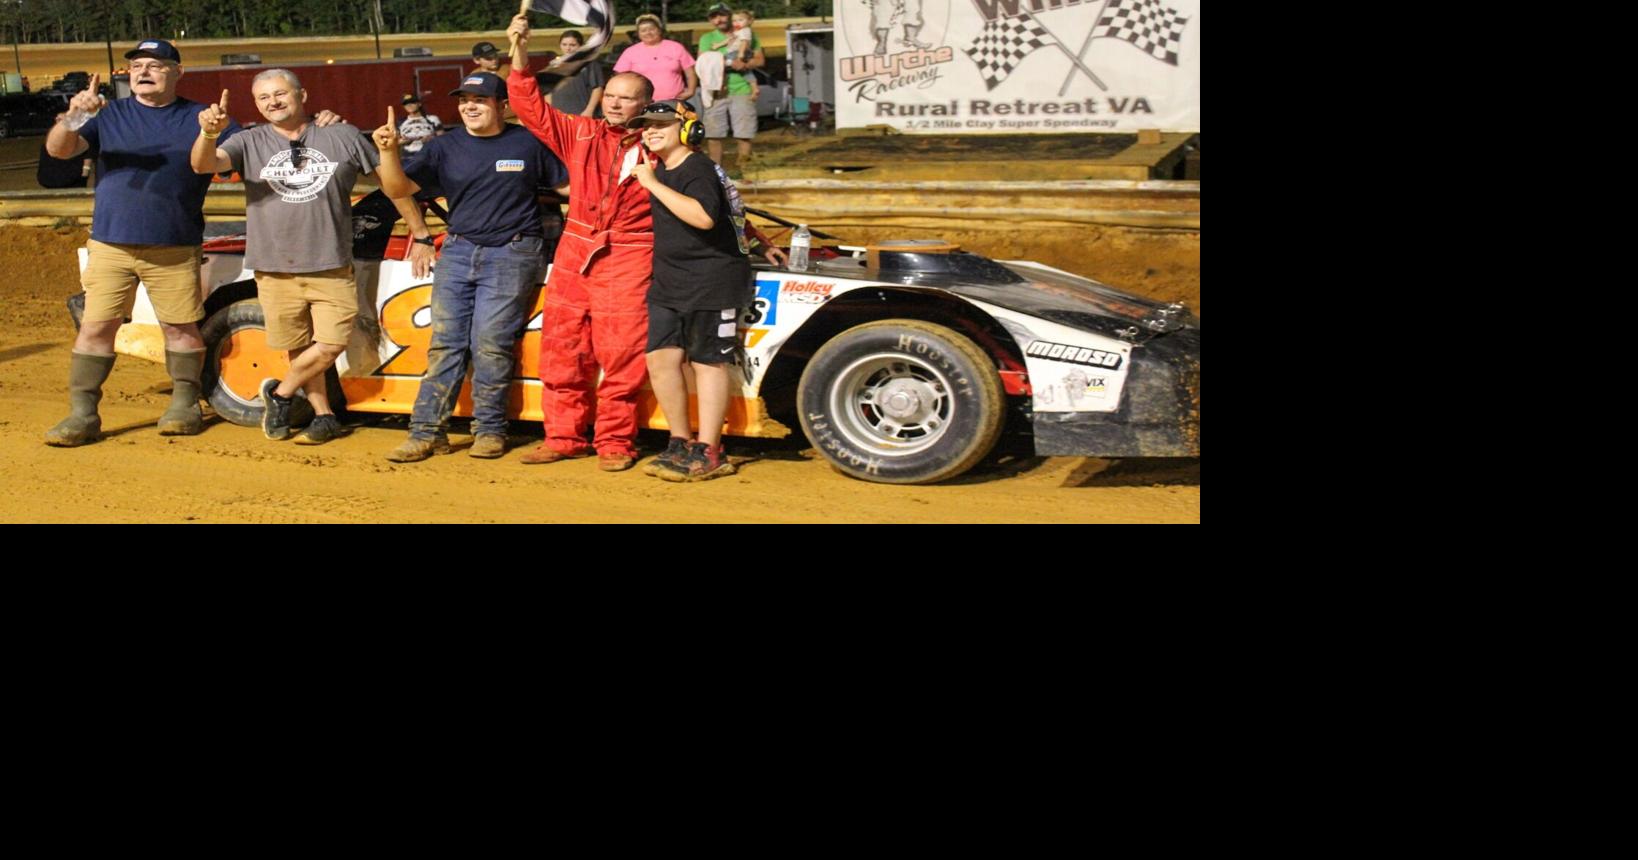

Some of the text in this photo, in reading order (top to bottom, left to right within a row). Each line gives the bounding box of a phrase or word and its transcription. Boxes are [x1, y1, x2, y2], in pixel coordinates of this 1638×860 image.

[840, 46, 953, 81] Wythe
[848, 67, 944, 103] Raceway
[875, 97, 1153, 117] Rural Retreat VA
[933, 119, 962, 128] Mile
[966, 119, 995, 129] Clay
[1000, 118, 1040, 129] Super
[1043, 118, 1118, 128] Speedway
[782, 280, 836, 296] Holley
[1027, 340, 1121, 369] MOROSO
